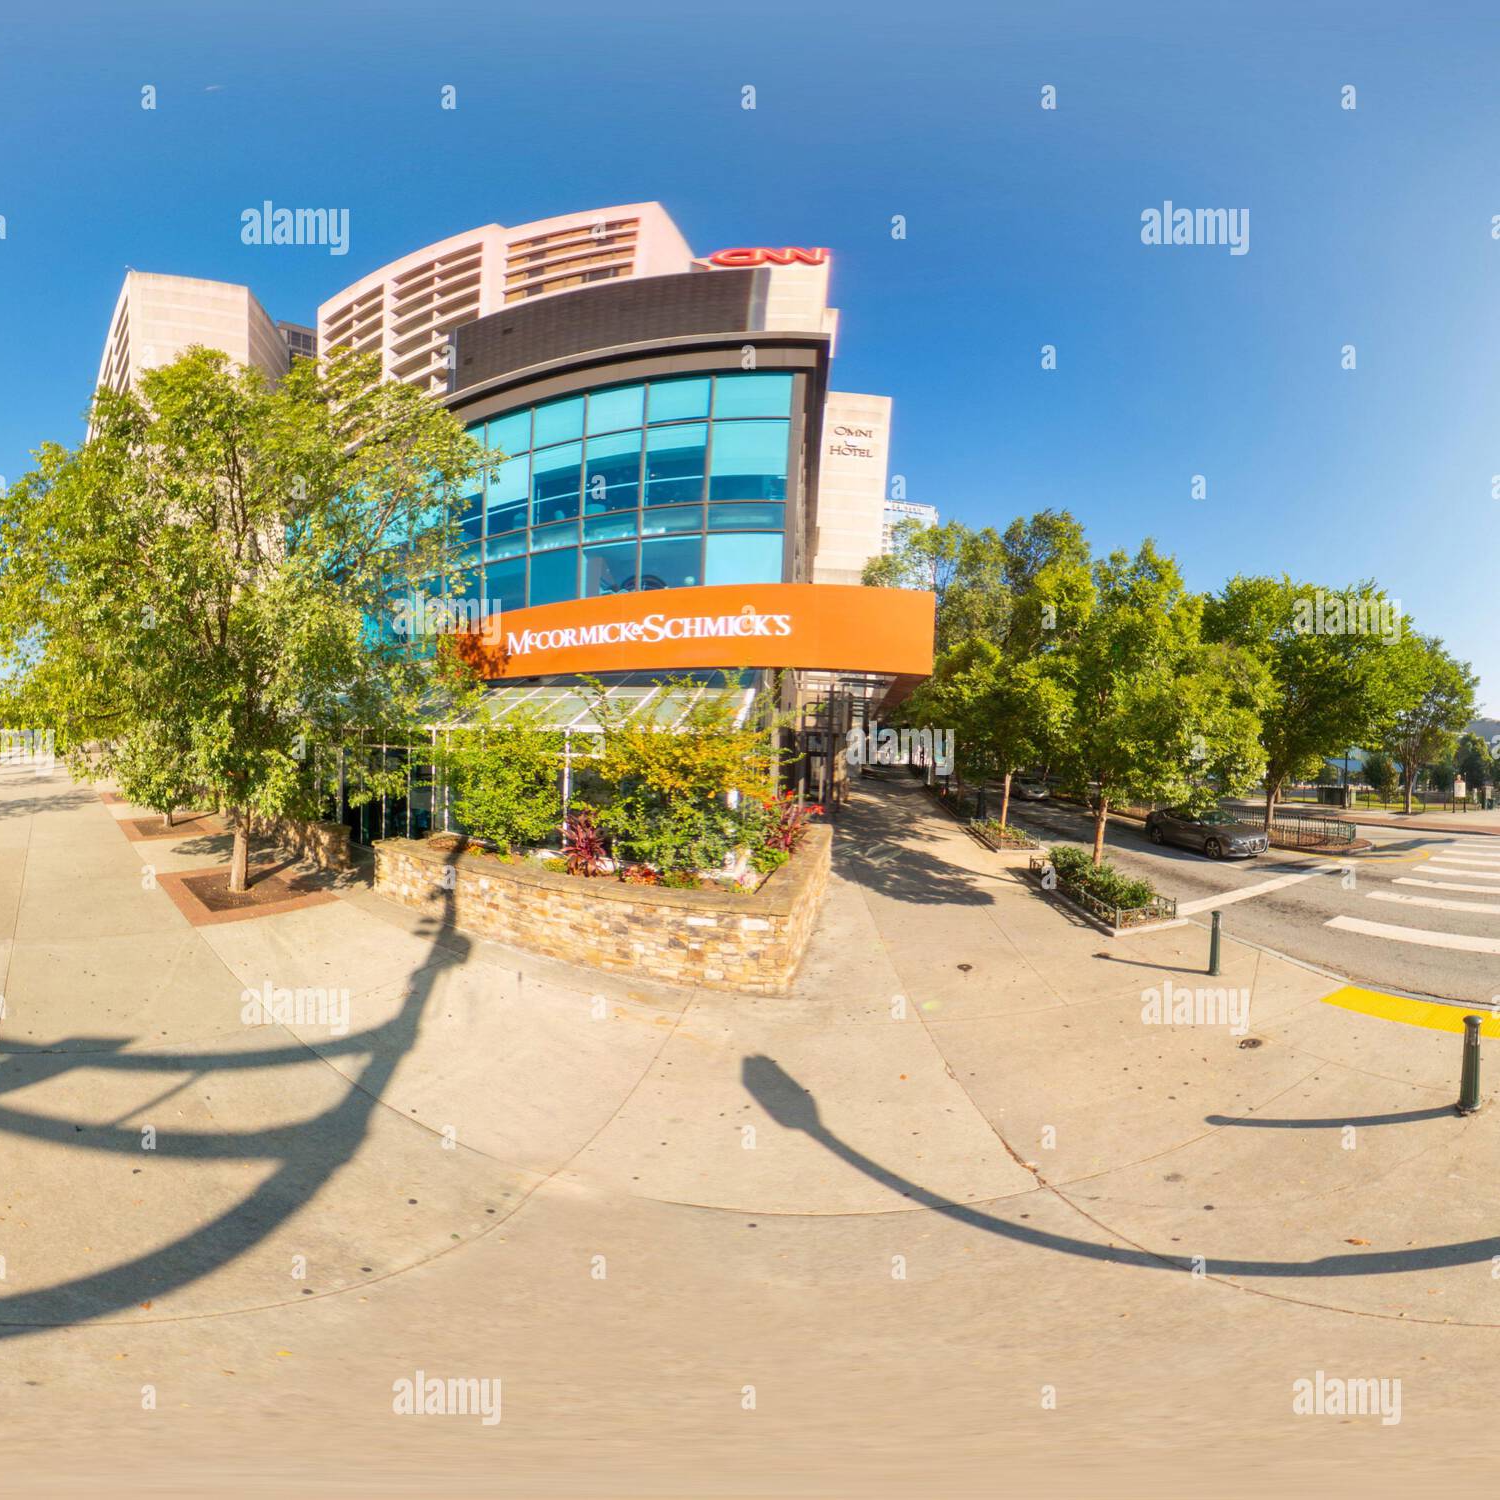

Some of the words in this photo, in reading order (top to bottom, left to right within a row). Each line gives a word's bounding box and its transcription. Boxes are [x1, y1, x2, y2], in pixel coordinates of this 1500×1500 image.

[709, 246, 829, 267] CNN
[834, 426, 873, 438] OMNI
[829, 445, 873, 458] HOTEL
